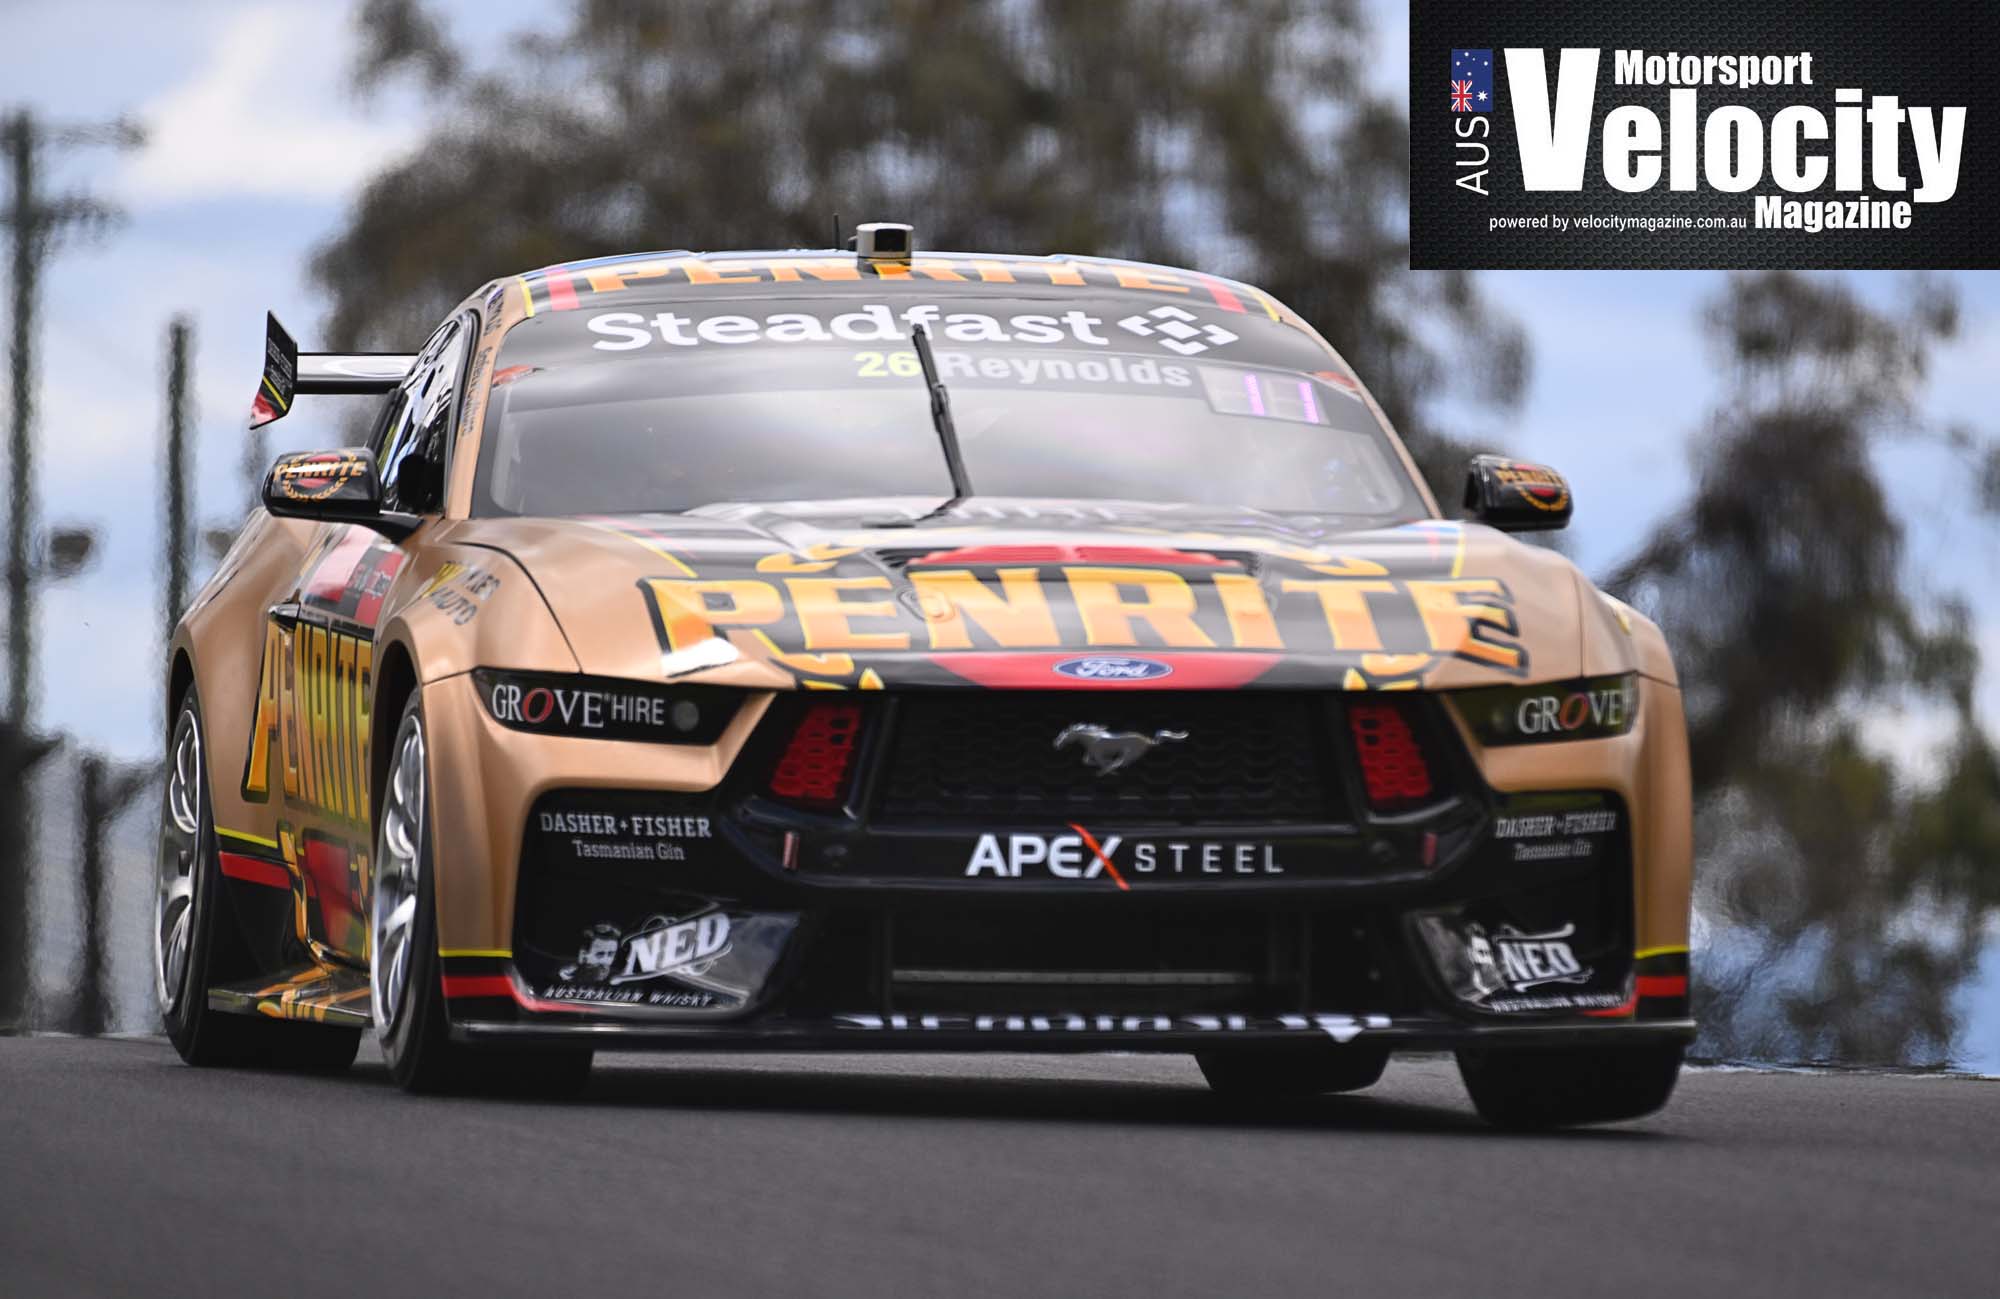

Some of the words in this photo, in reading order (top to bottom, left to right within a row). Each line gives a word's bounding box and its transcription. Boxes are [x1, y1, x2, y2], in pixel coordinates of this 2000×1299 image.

[586, 304, 1110, 351] Steadfast
[853, 351, 920, 378] 26
[937, 353, 1193, 388] Reynolds
[638, 566, 1528, 678] PENRITE
[1070, 659, 1151, 679] Ford
[492, 684, 604, 728] GROVE
[610, 694, 664, 726] HIRE
[540, 813, 616, 835] DASHER
[632, 816, 711, 837] FISHER
[572, 840, 654, 859] Tasmanian
[657, 845, 684, 860] Gin
[966, 823, 1130, 891] APEX
[1134, 843, 1284, 874] STEEL
[624, 912, 731, 977] NED
[1500, 942, 1581, 981] NED
